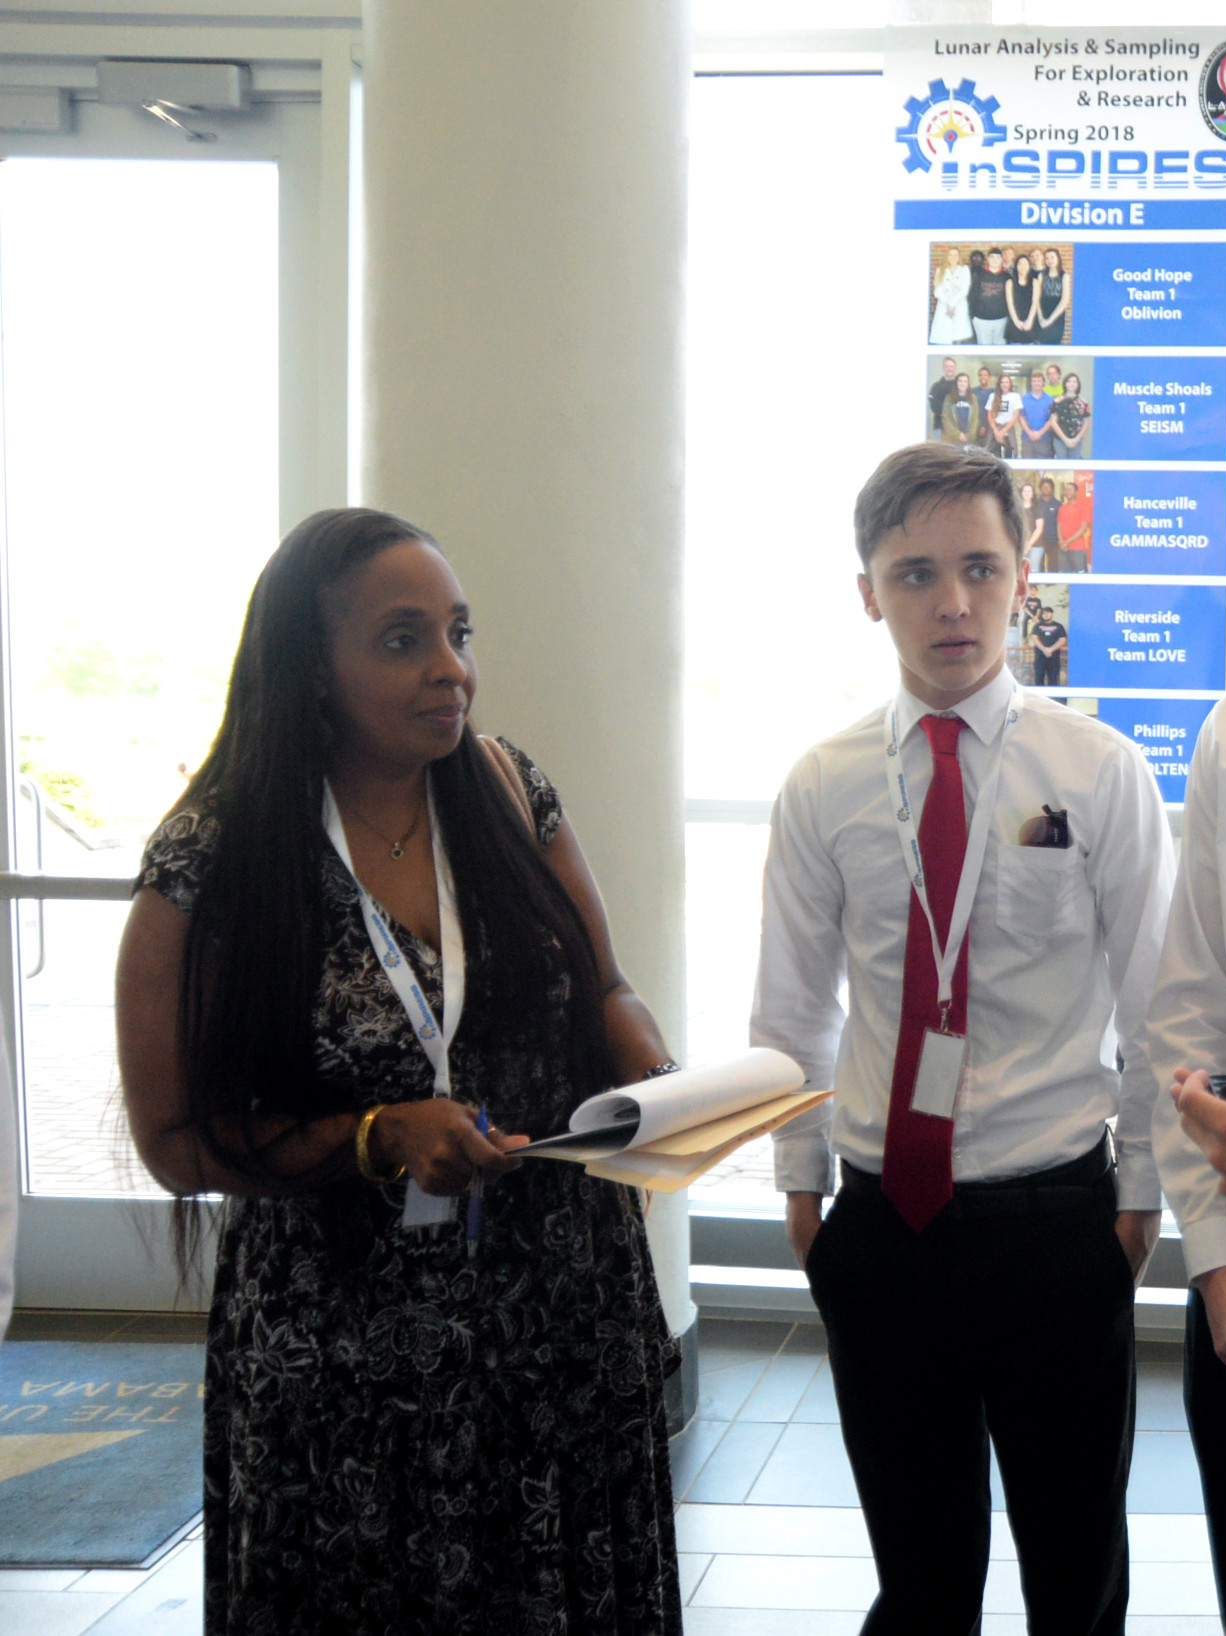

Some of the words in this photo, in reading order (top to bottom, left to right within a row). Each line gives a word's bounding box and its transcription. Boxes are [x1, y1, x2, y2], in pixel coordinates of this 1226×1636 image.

[935, 39, 990, 55] Lunar
[997, 39, 1079, 58] Analysis
[1085, 39, 1099, 55] &
[1104, 39, 1200, 59] Sampling
[1035, 66, 1066, 82] For
[1072, 65, 1189, 85] Exploration
[1077, 91, 1092, 107] &
[1098, 91, 1187, 107] Research
[1013, 125, 1080, 145] Spring
[1086, 126, 1135, 141] 2018
[1021, 202, 1123, 225] Division
[1130, 203, 1145, 224] E
[1112, 268, 1152, 283] Good
[1154, 268, 1193, 287] Hope
[1127, 287, 1165, 301] Team
[1169, 288, 1176, 301] 1
[1121, 305, 1182, 320] Oblivion
[1113, 382, 1163, 396] Muscle
[1165, 382, 1213, 396] Shoals
[1137, 402, 1176, 415] Team
[1179, 402, 1186, 415] 1
[1140, 420, 1184, 434] SEISM
[1123, 496, 1197, 511] Hanceville
[1134, 515, 1173, 529] Team
[1176, 516, 1183, 529] 1
[1110, 534, 1209, 550] GAMMASQRD
[1114, 610, 1181, 624] Riverside
[1122, 629, 1160, 643] Team
[1163, 630, 1171, 643] 1
[1107, 648, 1146, 662] Team
[1148, 649, 1187, 663] LOVE
[1133, 724, 1187, 741] Phillips
[1175, 744, 1183, 757] 1
